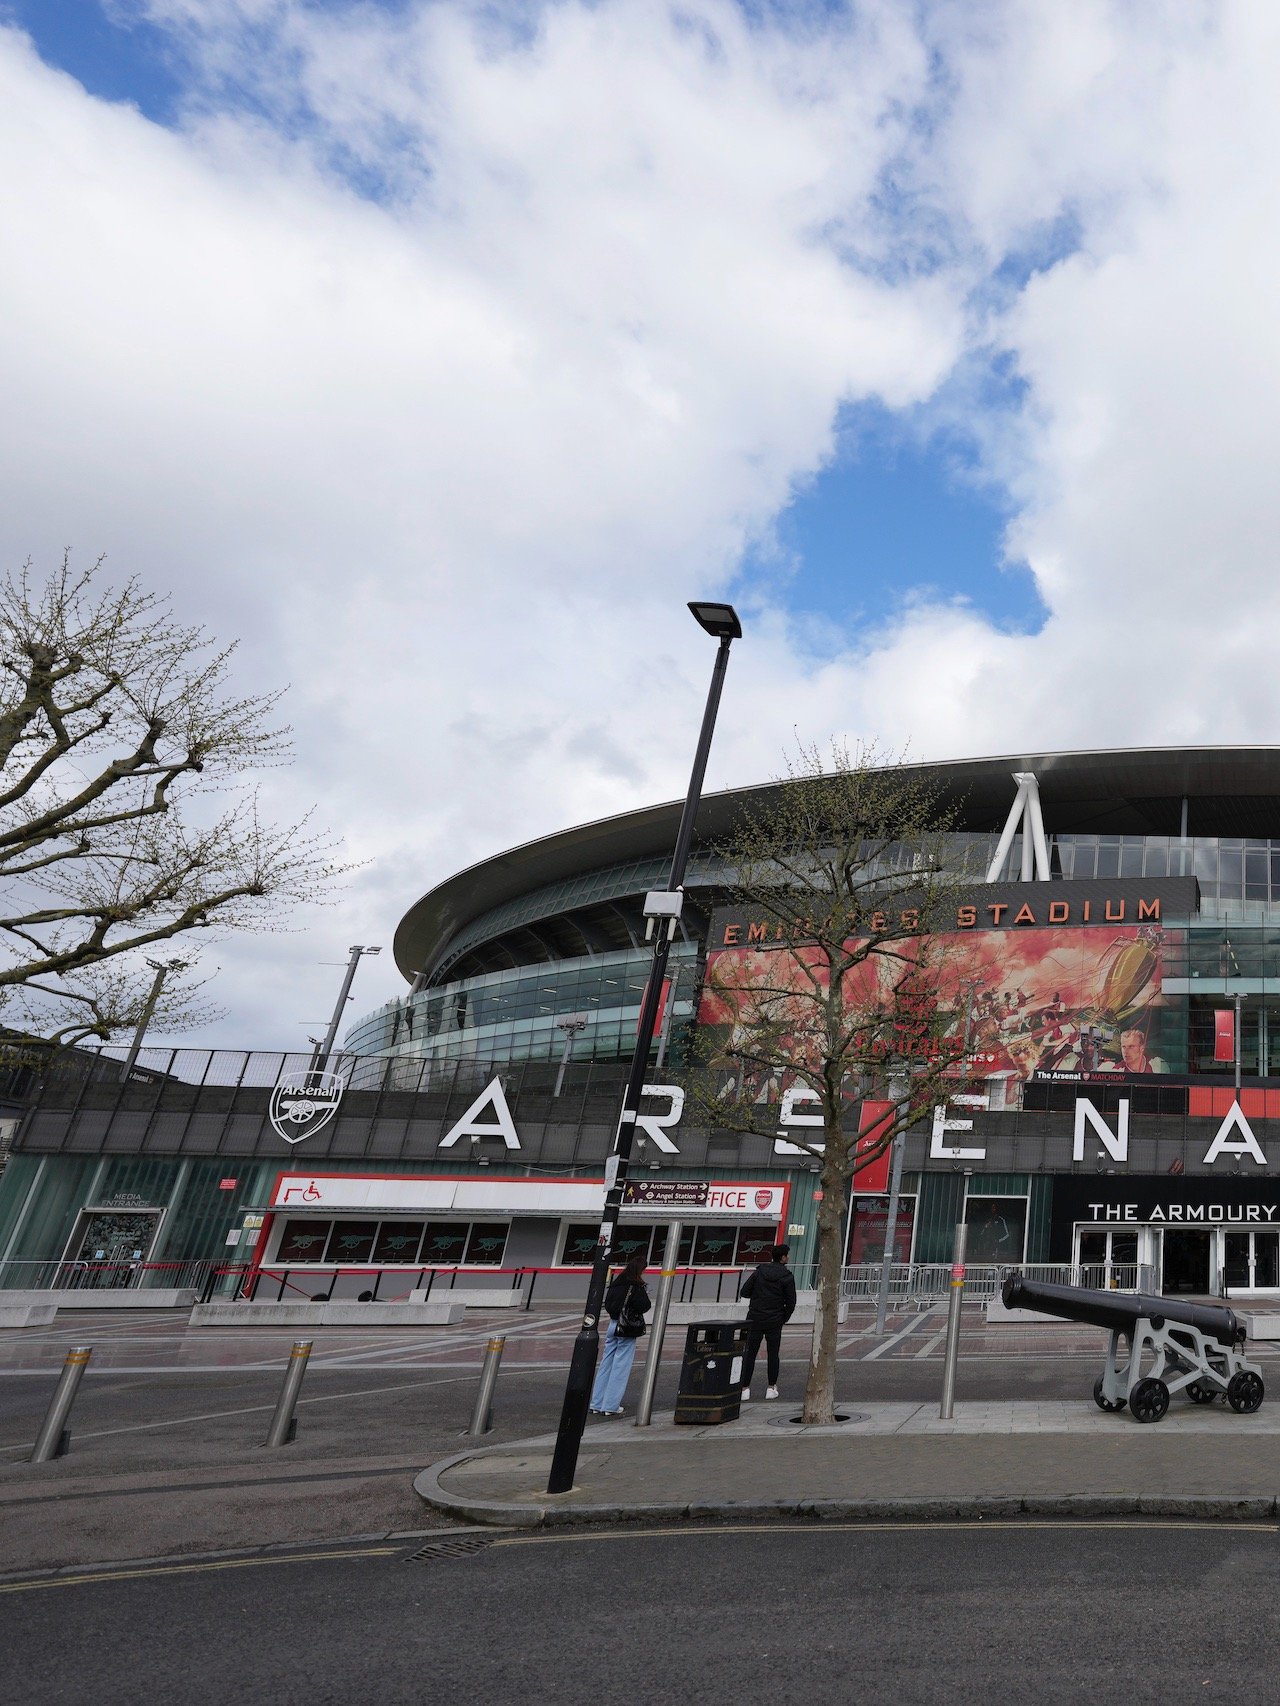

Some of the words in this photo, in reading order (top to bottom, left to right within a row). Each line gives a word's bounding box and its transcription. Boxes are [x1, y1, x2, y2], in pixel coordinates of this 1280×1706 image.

[957, 898, 1161, 927] STADIUM
[1037, 1071, 1051, 1080] The
[1052, 1071, 1081, 1081] Arsenal
[282, 1084, 334, 1097] Arsenal
[650, 1183, 675, 1191] Archway
[656, 1192, 672, 1200] Angel
[1088, 1204, 1138, 1220] THE
[1149, 1204, 1278, 1221] ARMOURY
